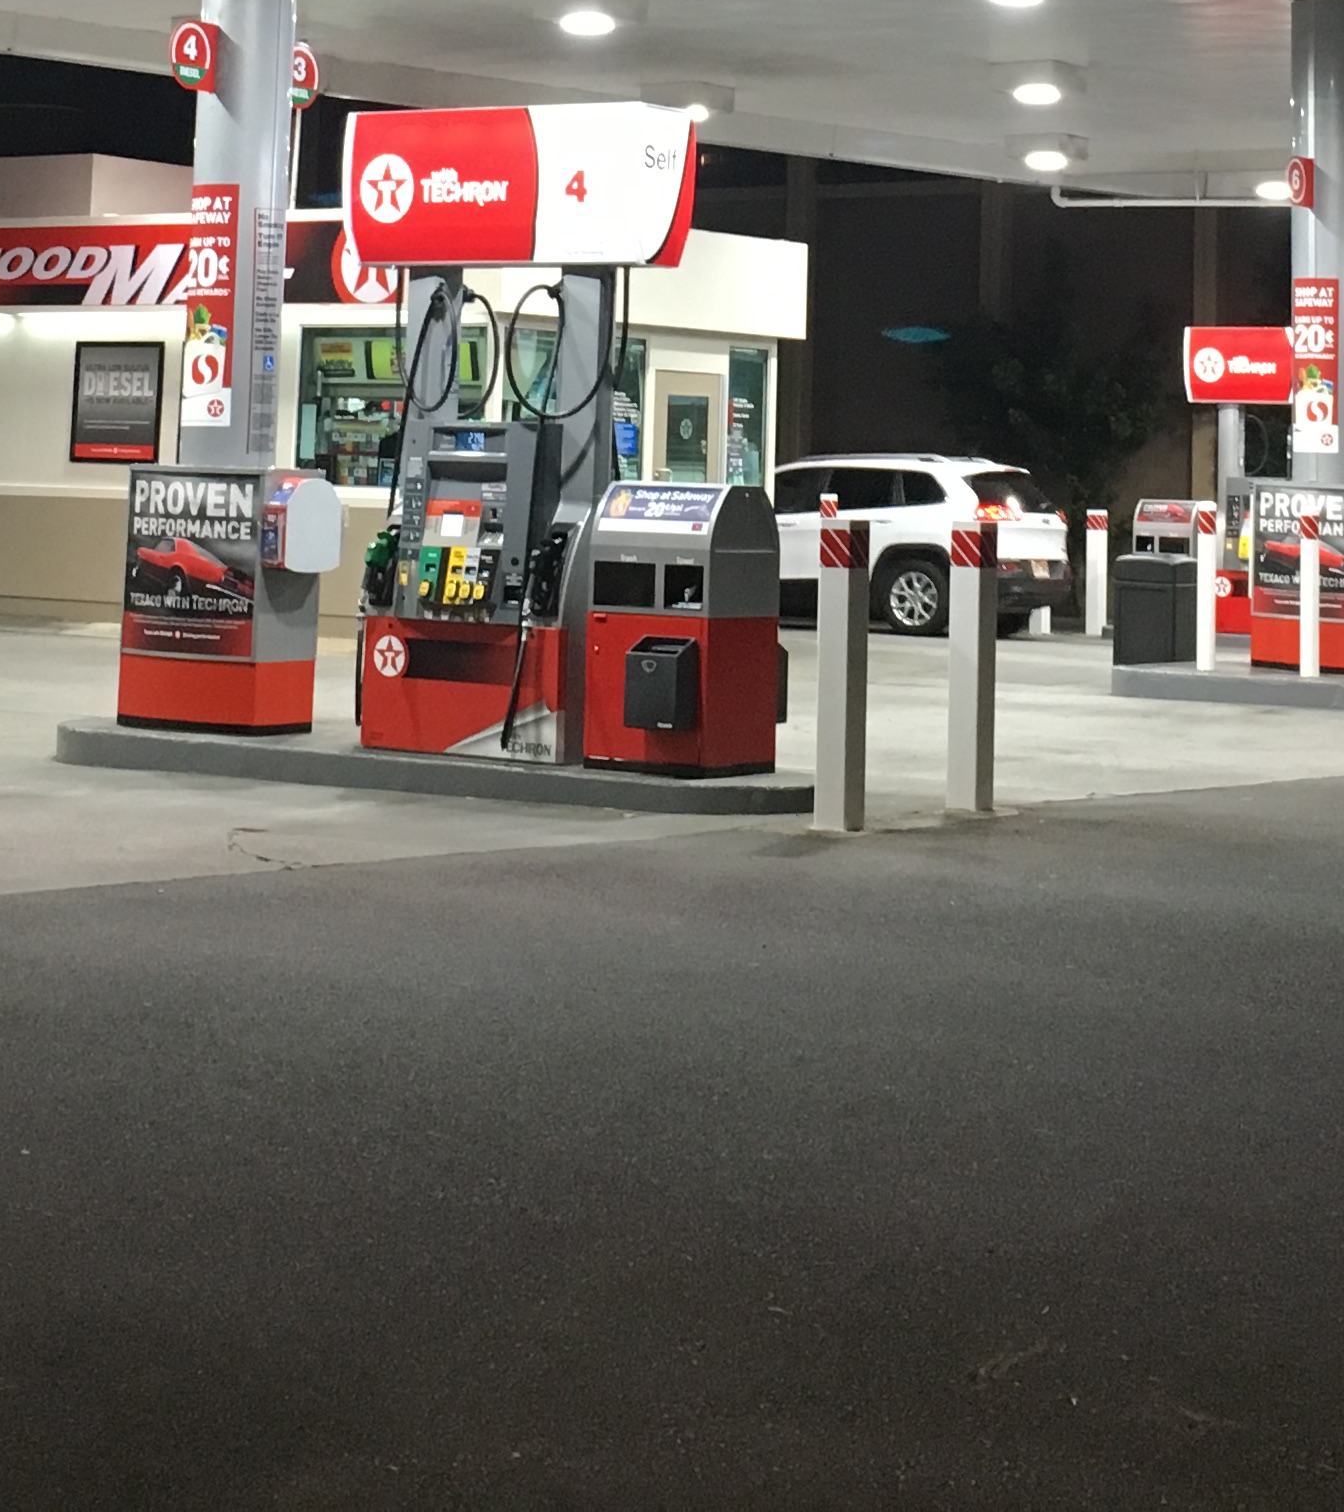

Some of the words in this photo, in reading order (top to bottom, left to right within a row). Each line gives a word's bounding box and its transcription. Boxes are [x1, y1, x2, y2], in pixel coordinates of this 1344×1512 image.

[183, 35, 198, 61] 4
[294, 57, 306, 81] 3
[644, 145, 677, 170] Self
[564, 170, 588, 202] 4
[1292, 169, 1299, 190] 6
[213, 196, 233, 210] AT
[421, 179, 508, 206] TECHRON
[1295, 287, 1317, 297] SHOP
[1319, 287, 1334, 297] AT
[135, 480, 254, 518] PROVEN
[635, 489, 658, 501] Shop
[671, 490, 713, 503] Safeway
[133, 516, 252, 540] PERFORMANCE
[130, 592, 162, 607] TEXACO
[192, 593, 250, 614] TECHRON
